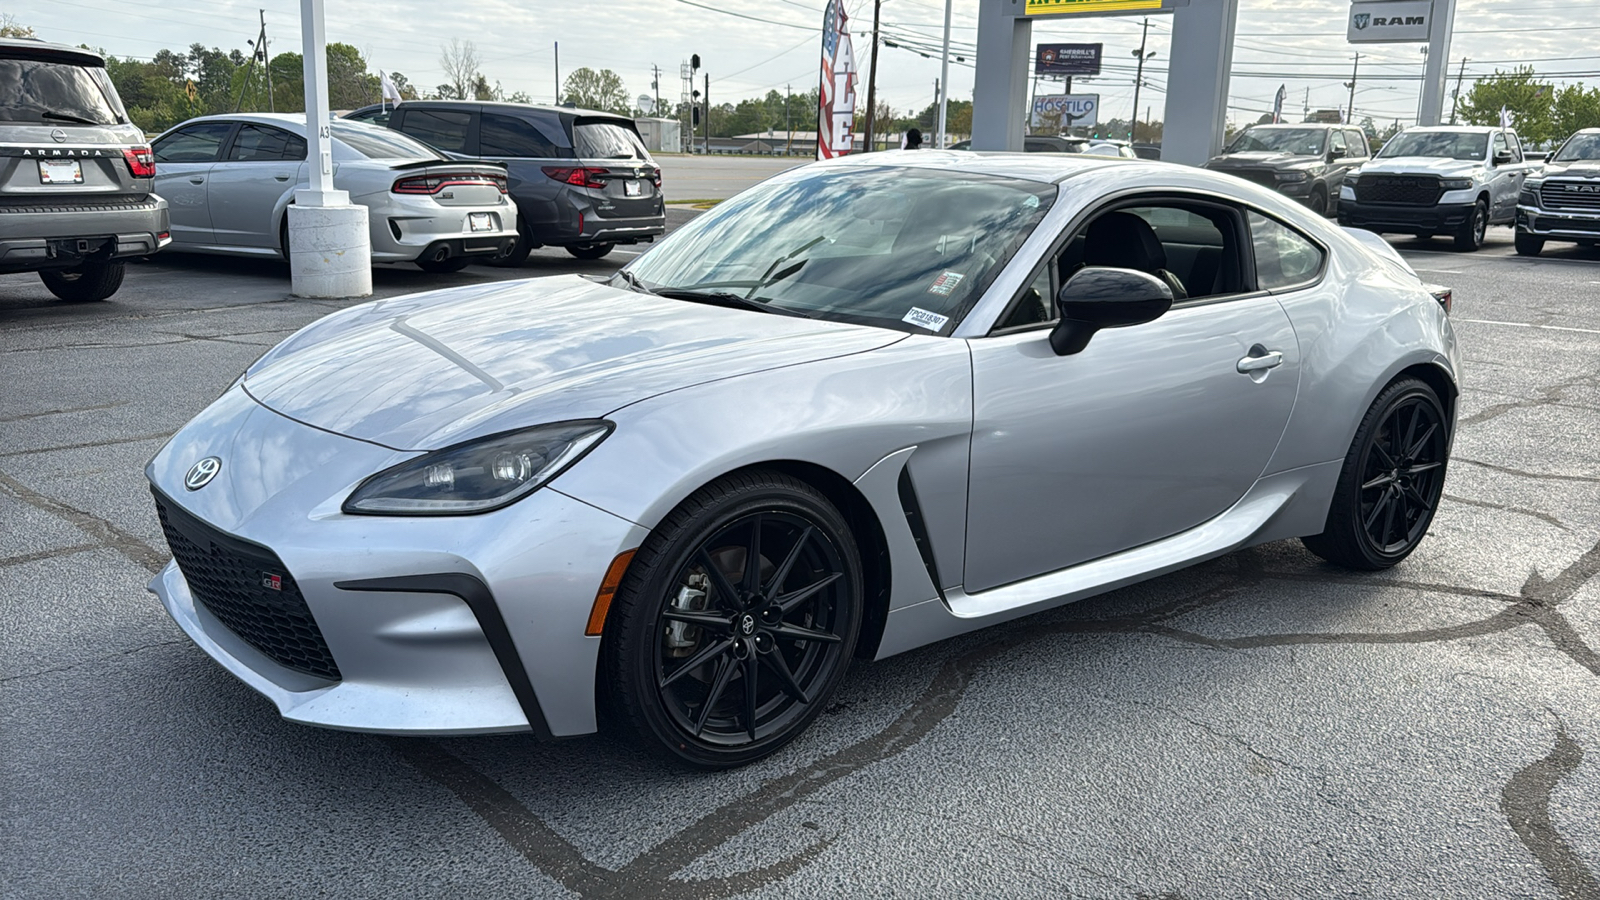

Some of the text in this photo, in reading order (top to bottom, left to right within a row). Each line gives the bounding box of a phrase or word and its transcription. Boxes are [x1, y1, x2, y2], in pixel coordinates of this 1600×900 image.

[1372, 16, 1425, 26] RAM
[1034, 100, 1094, 113] HOSTILO
[320, 126, 330, 139] A3
[263, 578, 281, 589] GR
